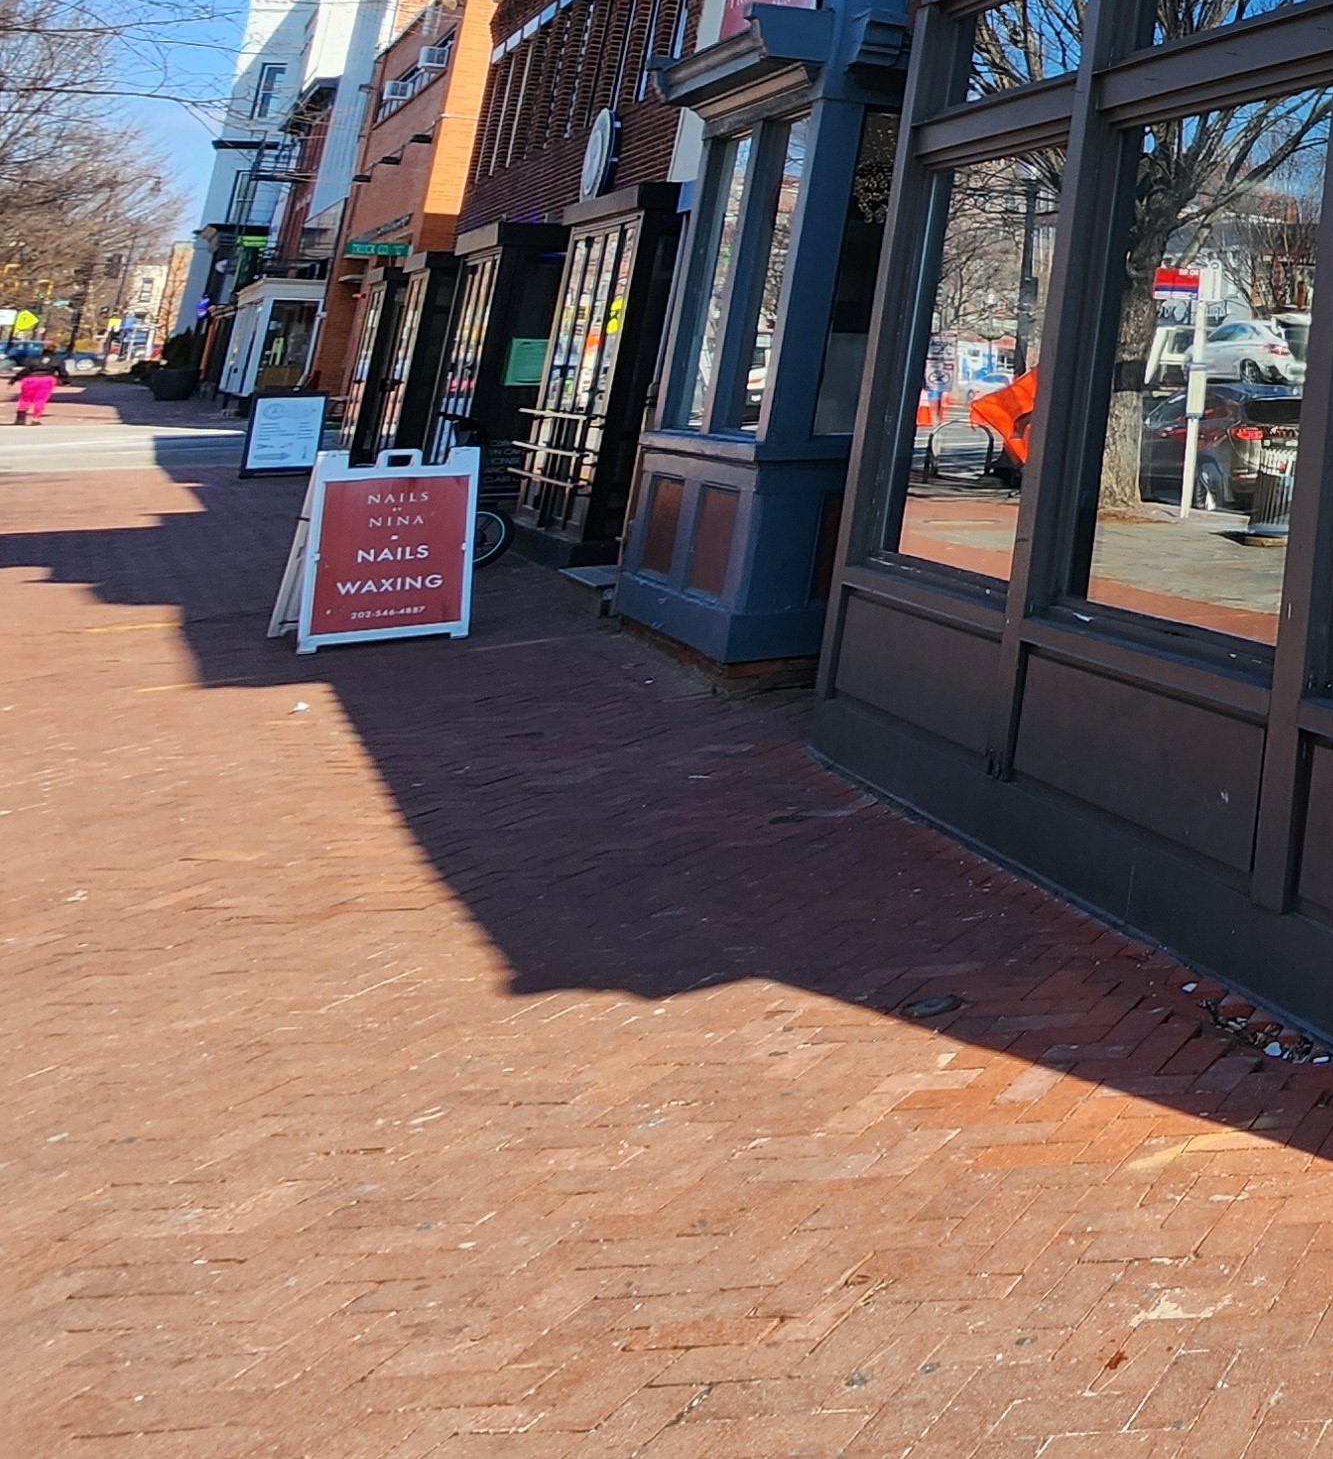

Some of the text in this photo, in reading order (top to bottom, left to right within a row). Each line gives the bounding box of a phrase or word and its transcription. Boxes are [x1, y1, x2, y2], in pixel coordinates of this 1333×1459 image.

[367, 491, 429, 505] NAILS
[368, 515, 424, 527] NINA
[356, 544, 430, 563] NAILS
[336, 573, 443, 596] WAXING
